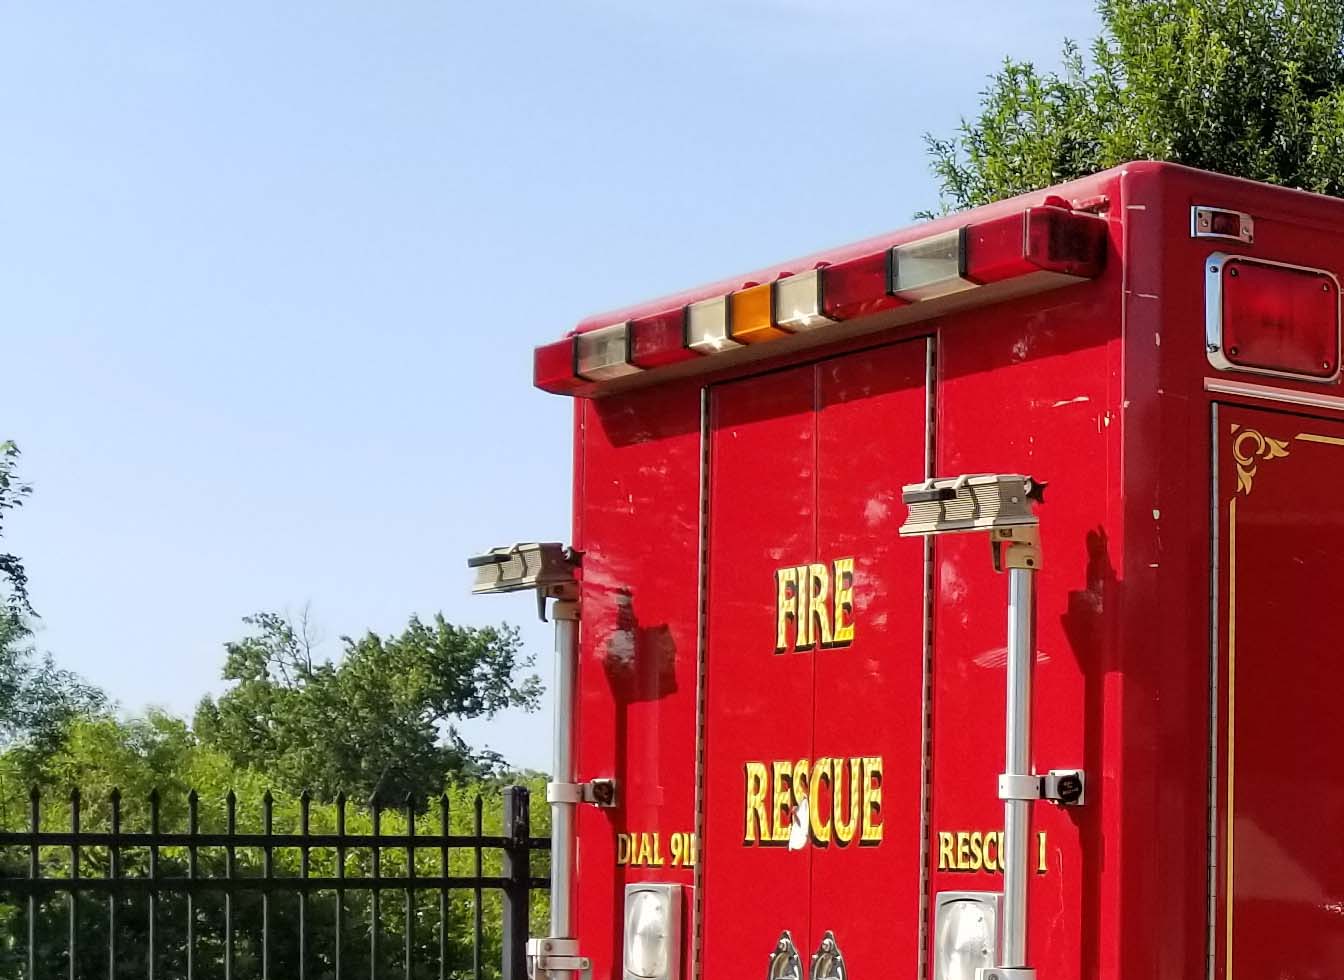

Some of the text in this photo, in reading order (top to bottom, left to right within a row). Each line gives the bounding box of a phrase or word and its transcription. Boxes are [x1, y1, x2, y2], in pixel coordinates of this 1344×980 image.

[775, 558, 855, 653] FIRE
[742, 755, 884, 851] RESCUE
[616, 832, 697, 869] DIAL 911
[937, 831, 1005, 873] RESC
